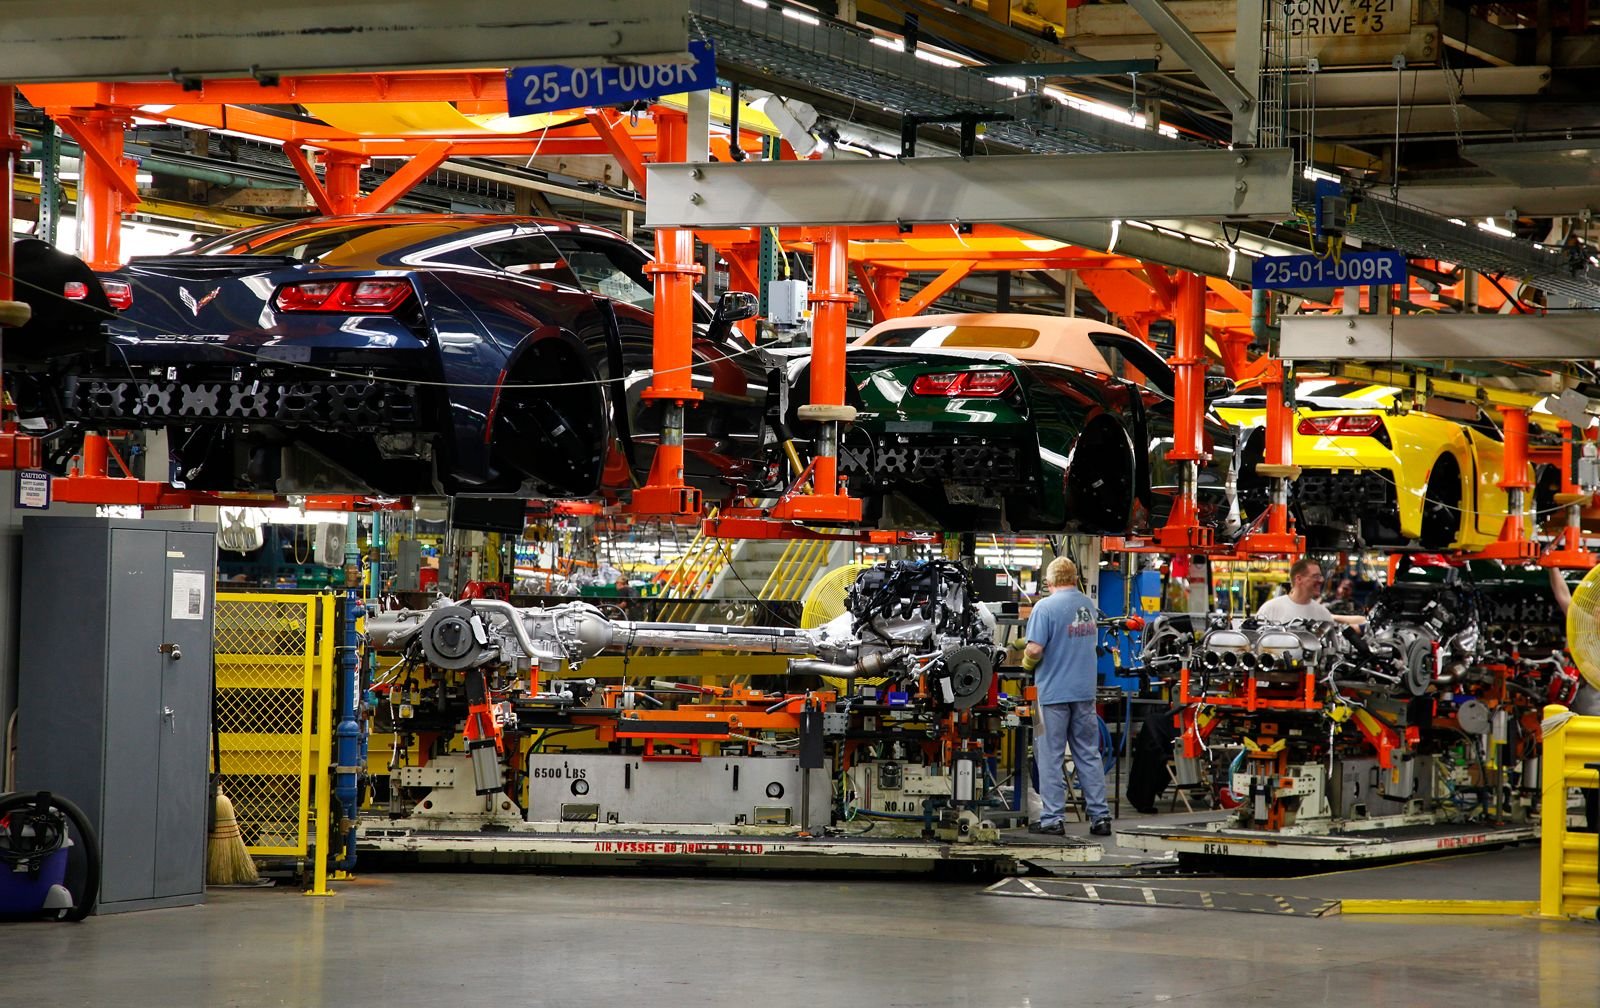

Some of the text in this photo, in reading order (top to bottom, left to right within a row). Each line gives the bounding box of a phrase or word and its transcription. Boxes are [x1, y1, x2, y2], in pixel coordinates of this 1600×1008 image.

[1292, 16, 1356, 35] DRIVE
[523, 63, 698, 106] 25-01-008R
[1265, 258, 1393, 283] 25-01-009R
[20, 472, 47, 480] CAUTION
[534, 768, 586, 779] 6500 LBS
[595, 842, 612, 852] AIR
[1204, 843, 1229, 855] REAR
